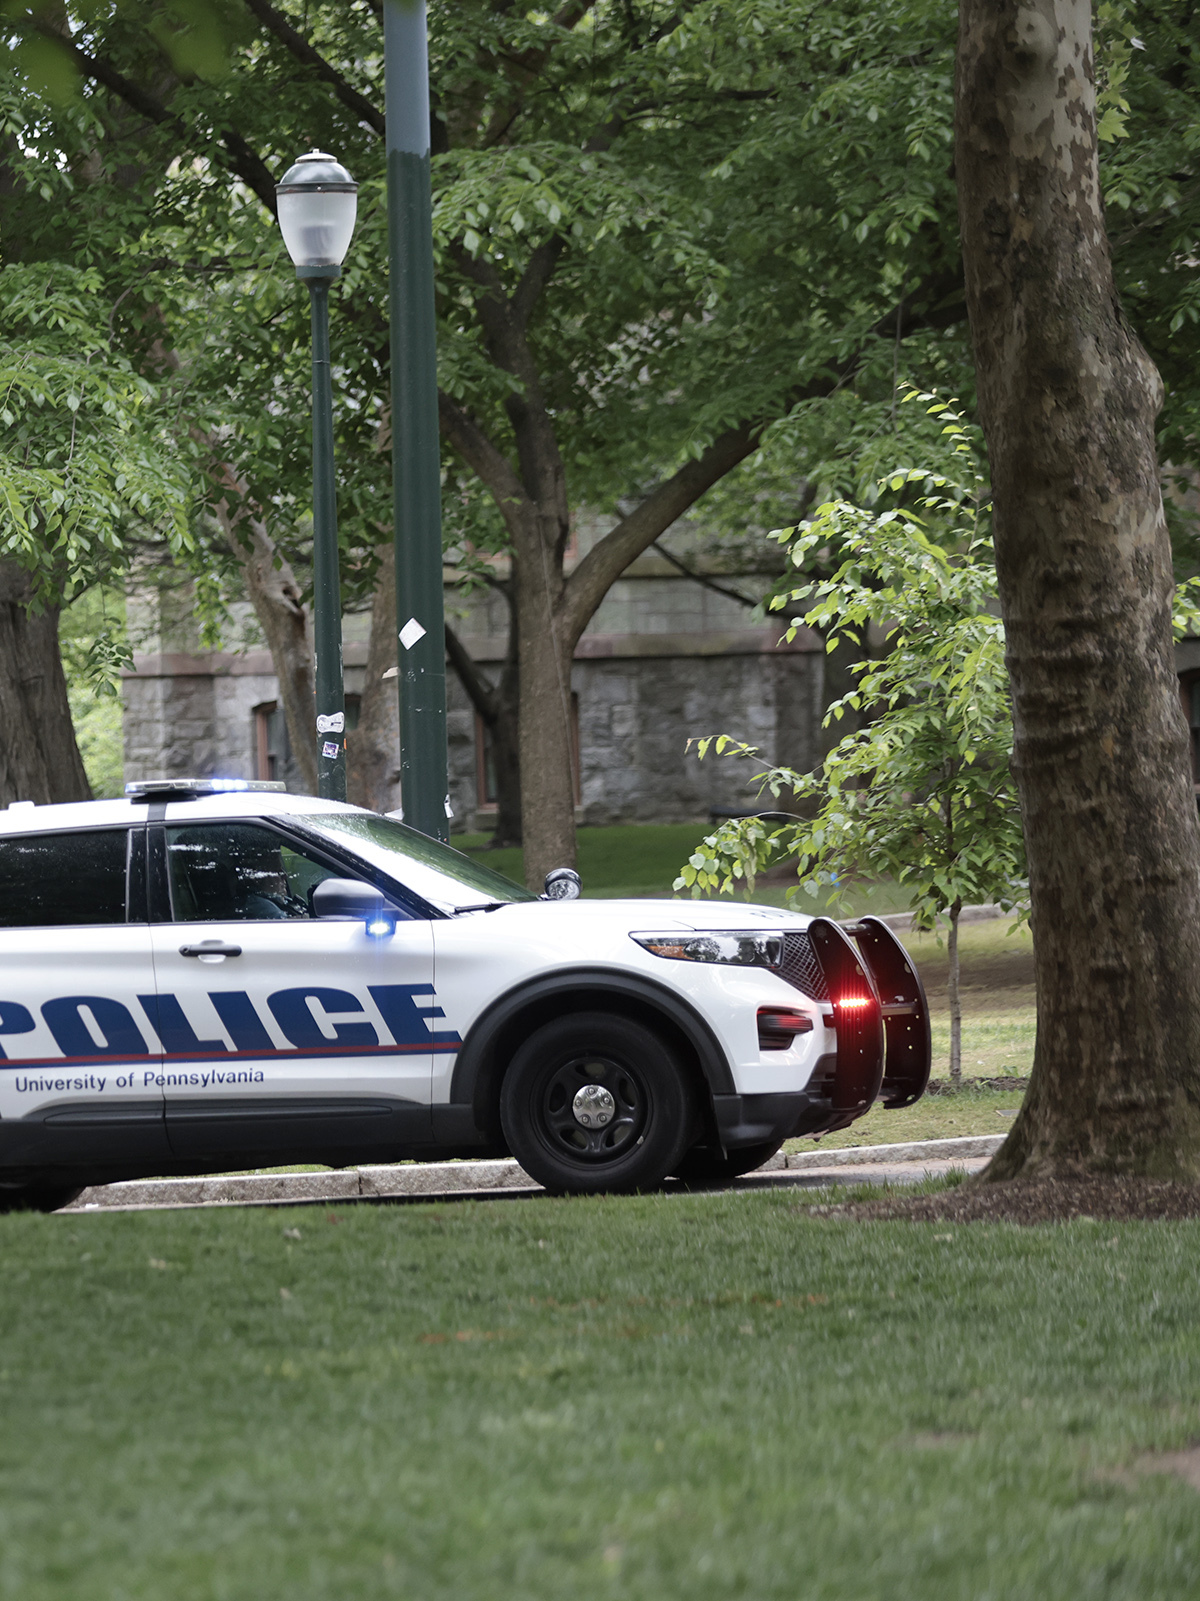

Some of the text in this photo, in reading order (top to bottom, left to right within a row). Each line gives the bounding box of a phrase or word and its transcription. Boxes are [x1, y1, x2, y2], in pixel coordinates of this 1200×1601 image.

[15, 1068, 265, 1093] University of Pennsylvania
